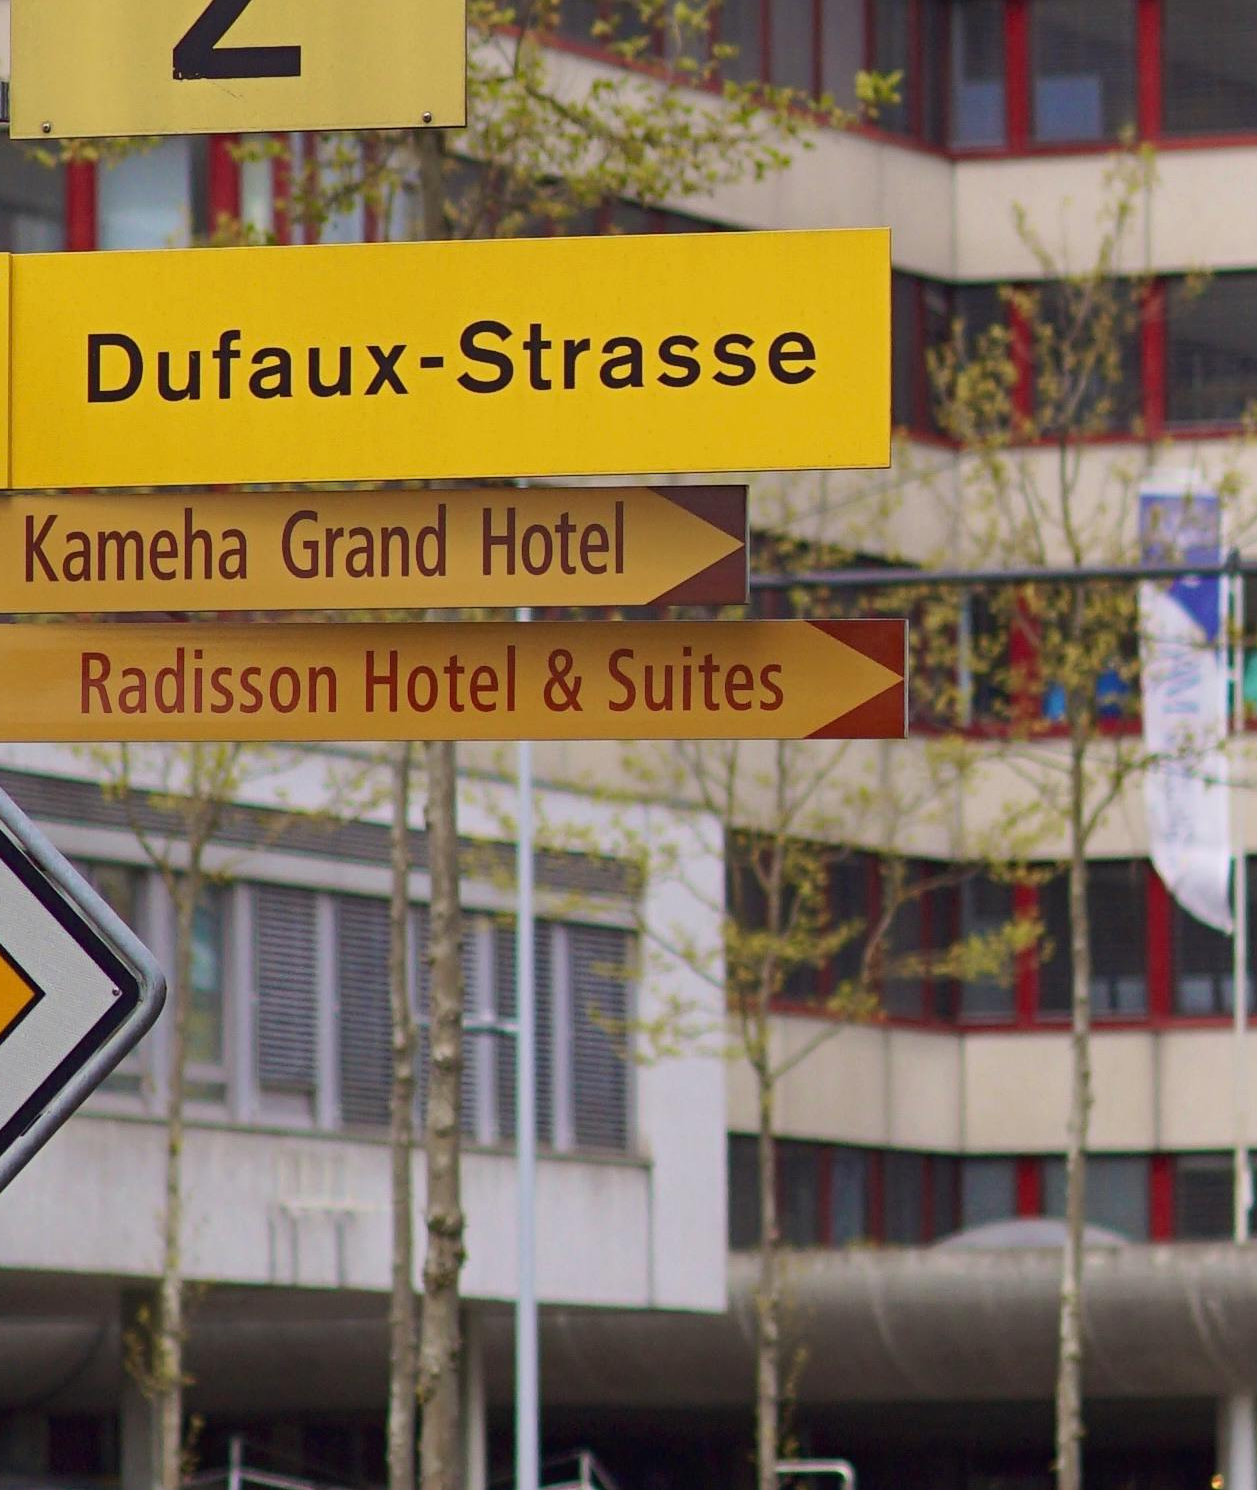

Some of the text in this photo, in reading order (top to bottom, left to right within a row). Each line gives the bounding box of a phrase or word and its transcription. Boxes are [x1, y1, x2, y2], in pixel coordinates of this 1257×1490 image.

[86, 319, 818, 404] Dufaux-Strasse
[24, 505, 248, 584] Kameha
[280, 502, 448, 580] Grand
[480, 500, 627, 577] Hotel
[80, 644, 785, 715] Radisson Hotel & Suites
